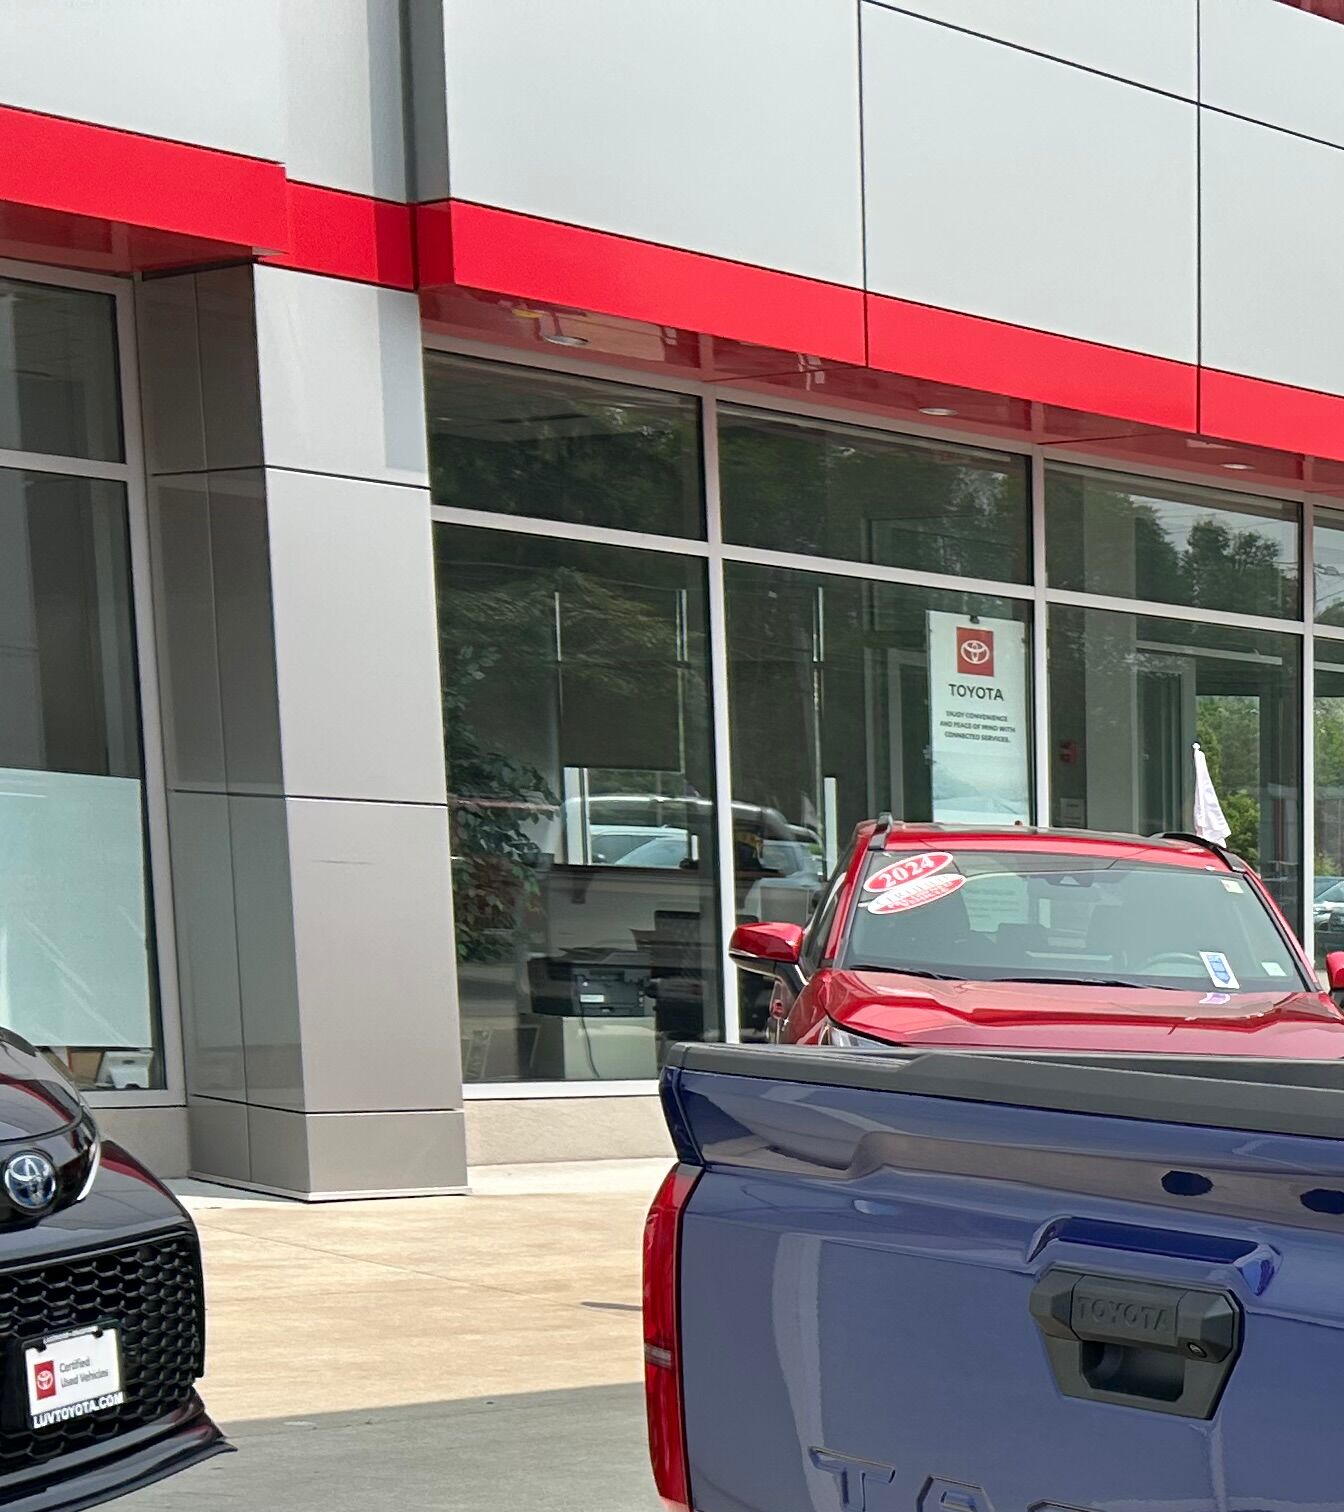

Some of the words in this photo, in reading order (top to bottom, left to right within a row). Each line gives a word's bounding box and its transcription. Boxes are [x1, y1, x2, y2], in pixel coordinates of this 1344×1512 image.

[947, 683, 1005, 702] TOYOTA
[878, 854, 936, 888] 2024
[1077, 1296, 1170, 1331] TOYOTA
[32, 1391, 124, 1429] LUVTOYOTA.COM
